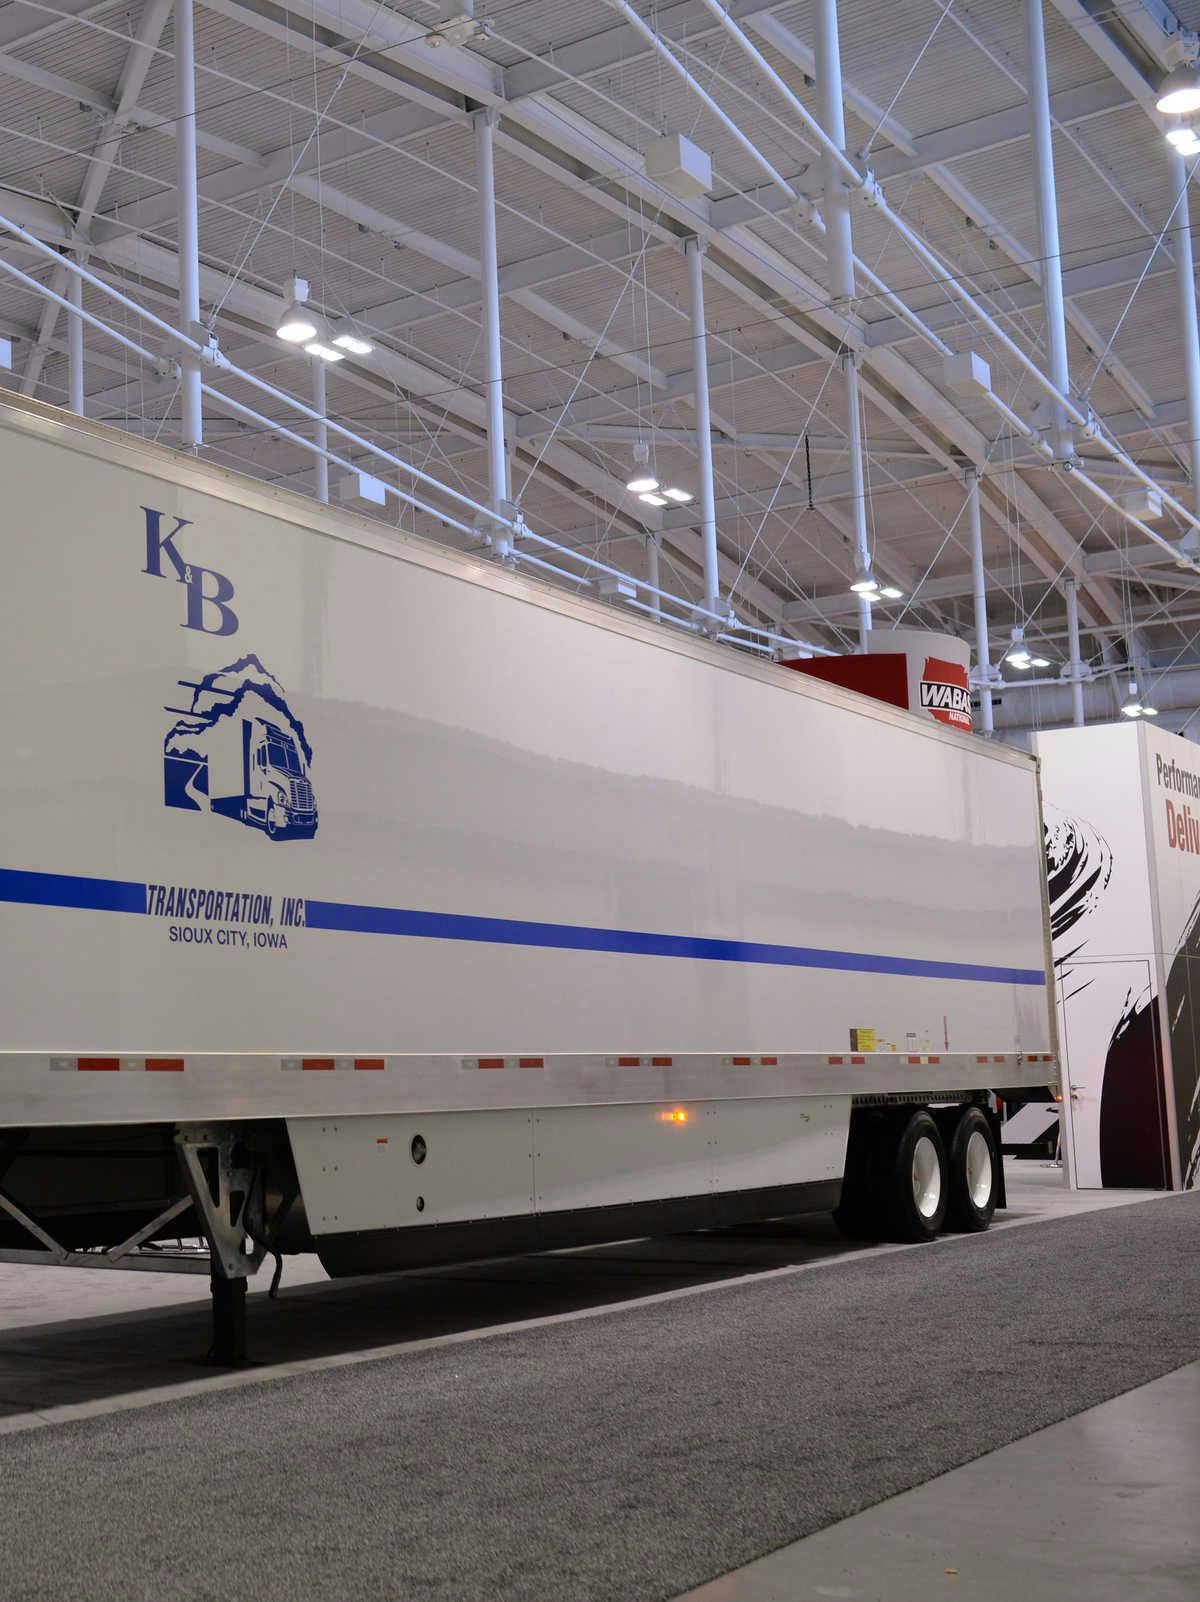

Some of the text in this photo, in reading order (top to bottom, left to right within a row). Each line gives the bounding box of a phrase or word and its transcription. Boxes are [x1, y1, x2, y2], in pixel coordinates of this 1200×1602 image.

[1156, 753, 1200, 799] Performa
[148, 884, 305, 928] TRANSPORTATION, INC.
[169, 926, 288, 949] SIOUX CITY, IOWA
